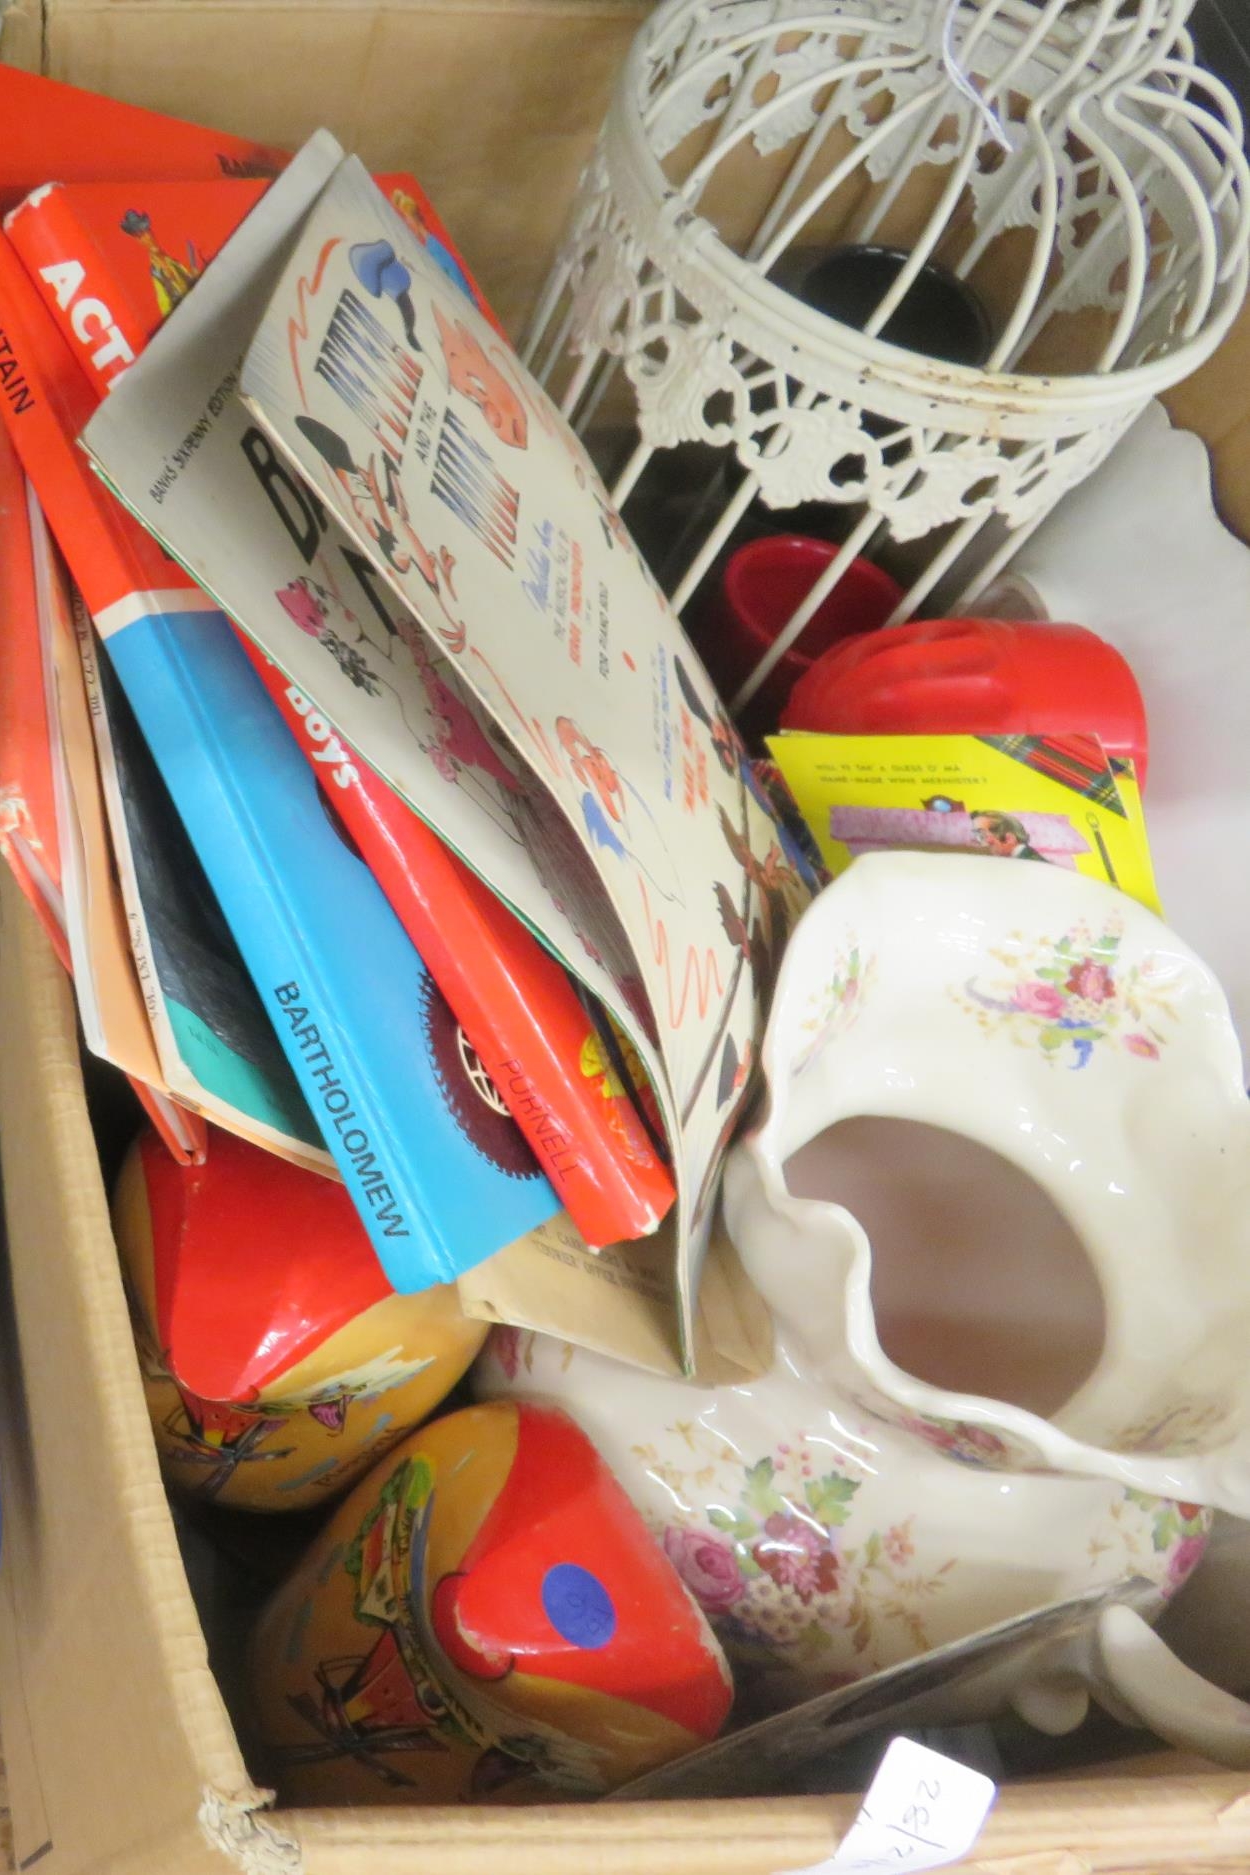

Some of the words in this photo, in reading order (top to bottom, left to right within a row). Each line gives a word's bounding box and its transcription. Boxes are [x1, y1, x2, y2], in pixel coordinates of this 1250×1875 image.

[38, 260, 136, 391] ACT
[172, 414, 213, 469] SIXPENNY
[415, 427, 432, 466] AND
[419, 401, 438, 430] THE
[273, 980, 410, 1238] BARTHOLOMEW
[499, 1058, 579, 1183] PURNELL
